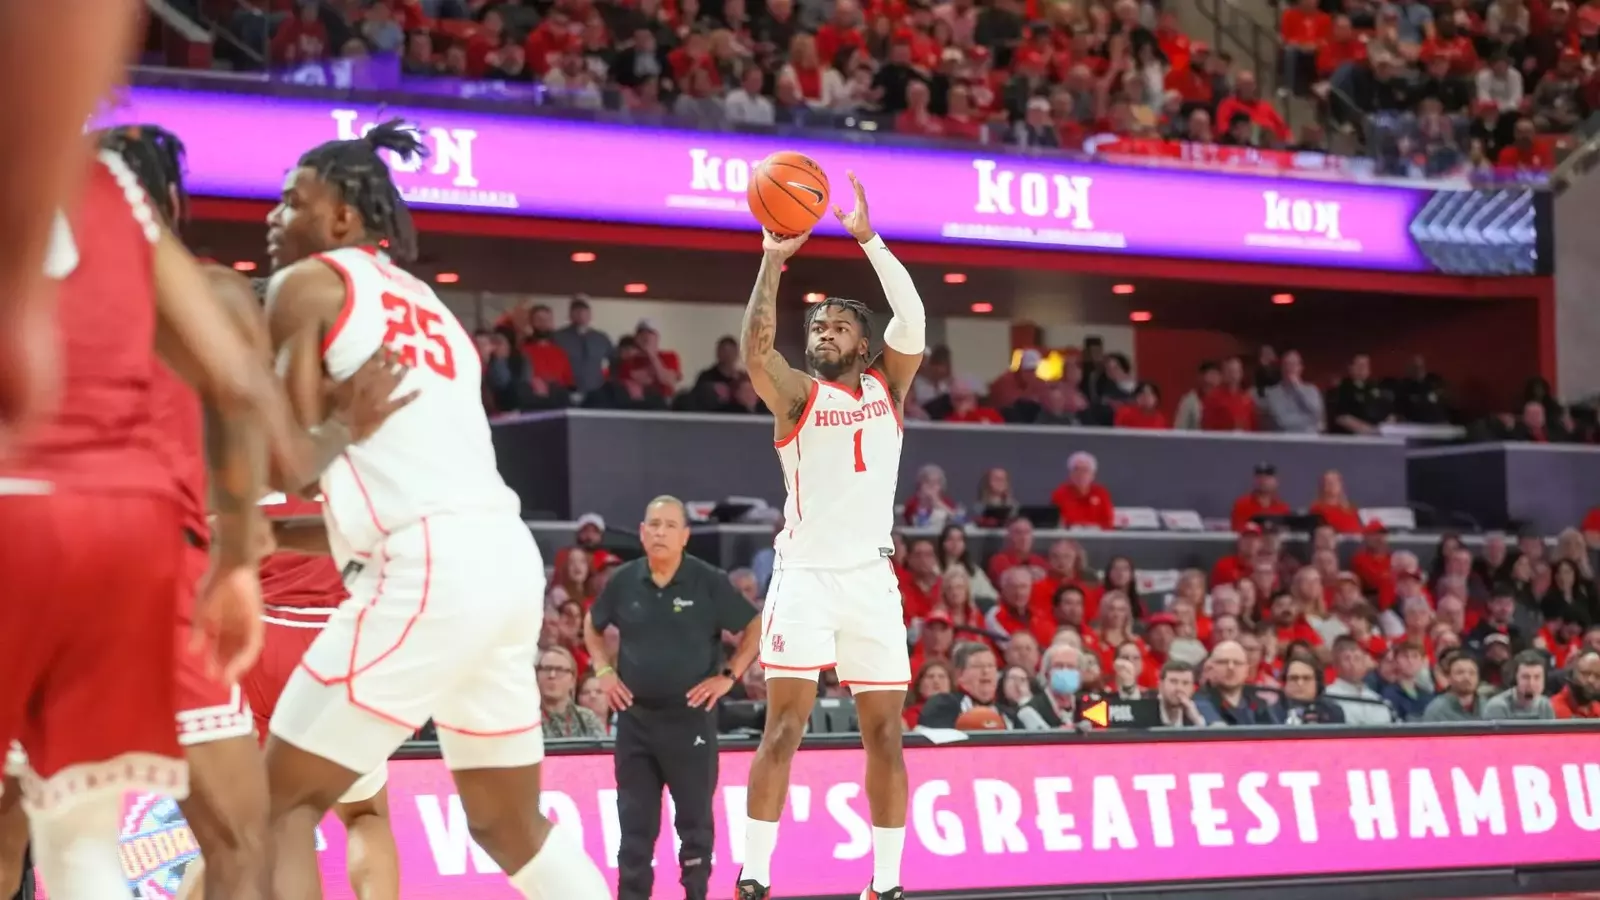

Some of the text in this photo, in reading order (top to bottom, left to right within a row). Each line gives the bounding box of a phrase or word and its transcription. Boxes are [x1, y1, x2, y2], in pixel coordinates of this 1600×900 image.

[381, 292, 456, 380] 25
[815, 398, 889, 426] HOUSTON
[853, 428, 866, 472] 1
[912, 769, 1320, 856] GREATEST
[1347, 763, 1600, 840] HAMBU
